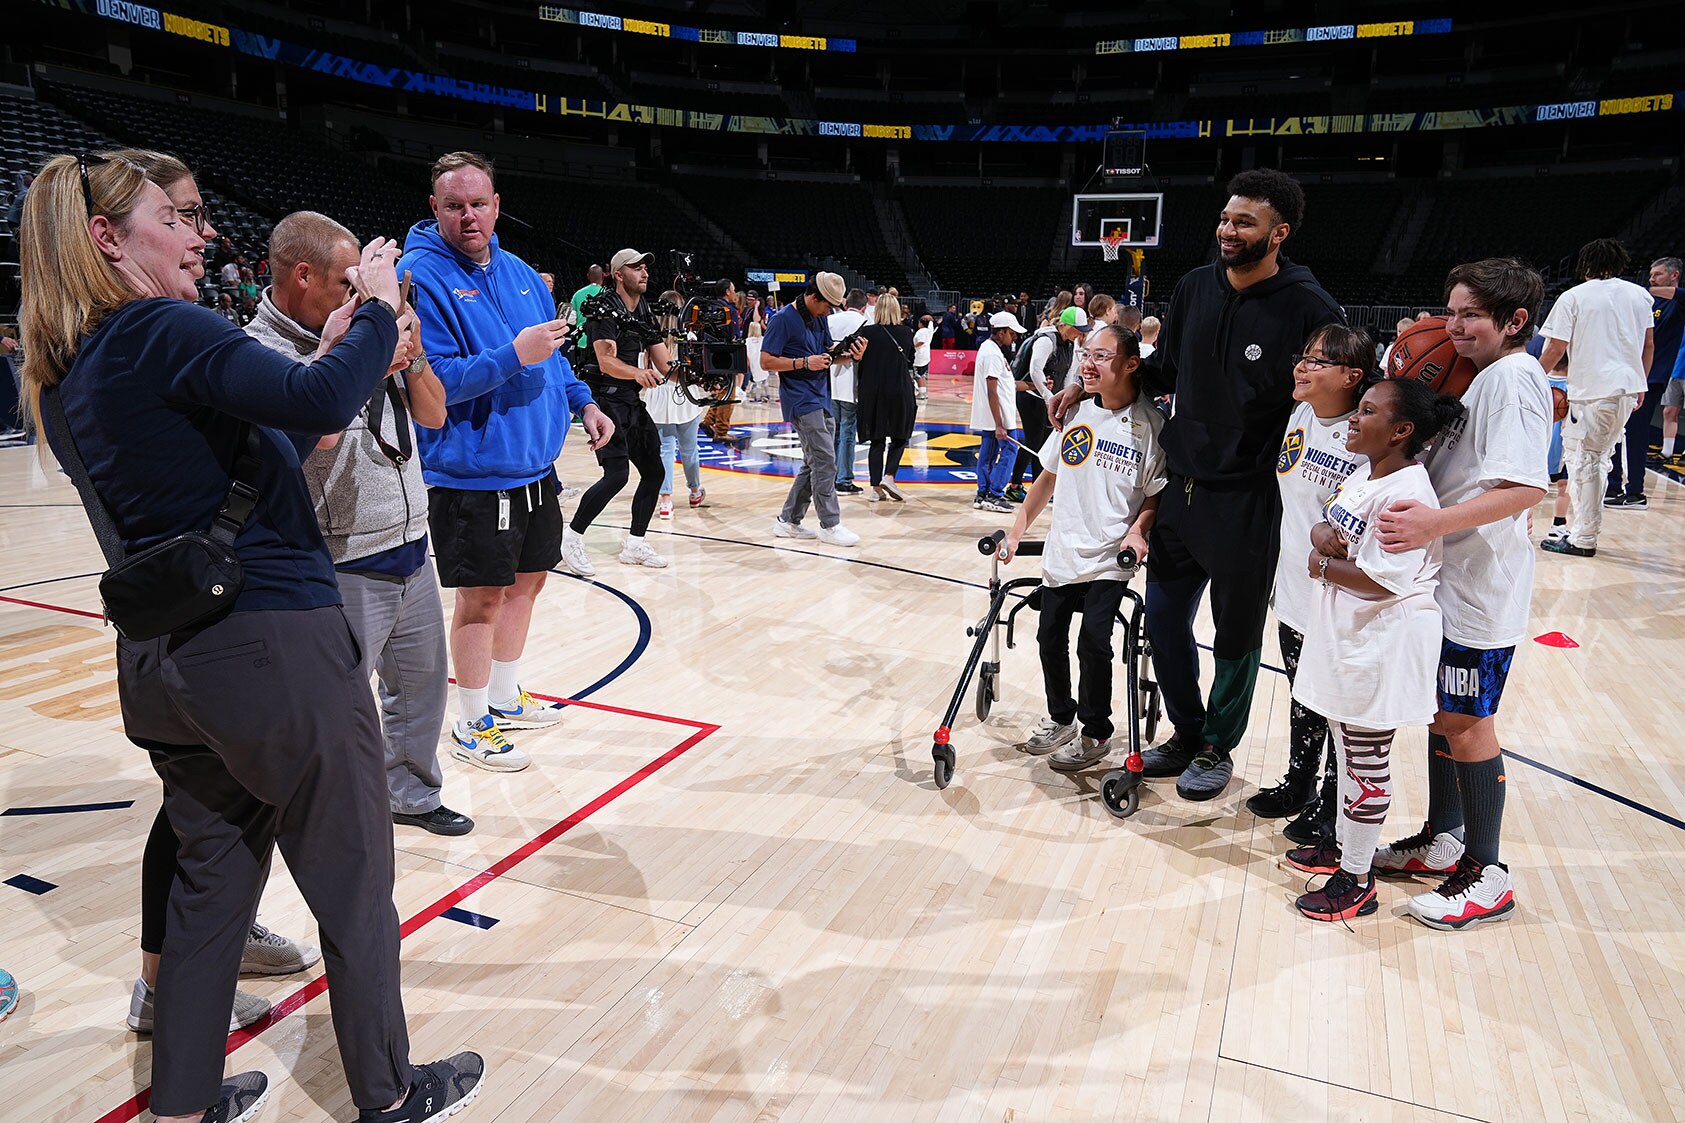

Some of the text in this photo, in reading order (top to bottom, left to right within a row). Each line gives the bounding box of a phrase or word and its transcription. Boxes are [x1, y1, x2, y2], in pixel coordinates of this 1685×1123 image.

[96, 0, 230, 46] DENVER NUGGETS
[579, 11, 671, 37] DENVER NUGGETS
[1306, 21, 1414, 41] DENVER NUGGETS
[737, 31, 827, 51] DENVER NUGGETS
[1134, 33, 1231, 52] DENVER NUGGETS
[1536, 93, 1674, 121] DENVER NUGGETS
[818, 121, 912, 139] DENVER NUGGETS
[1094, 450, 1139, 470] SPECIAL OLYMPICS
[1096, 438, 1143, 464] NUGGETS
[1096, 459, 1133, 477] CLINIC
[1300, 460, 1321, 474] SPECIAL
[1304, 447, 1358, 476] NUGGETS
[1444, 665, 1480, 698] NBA
